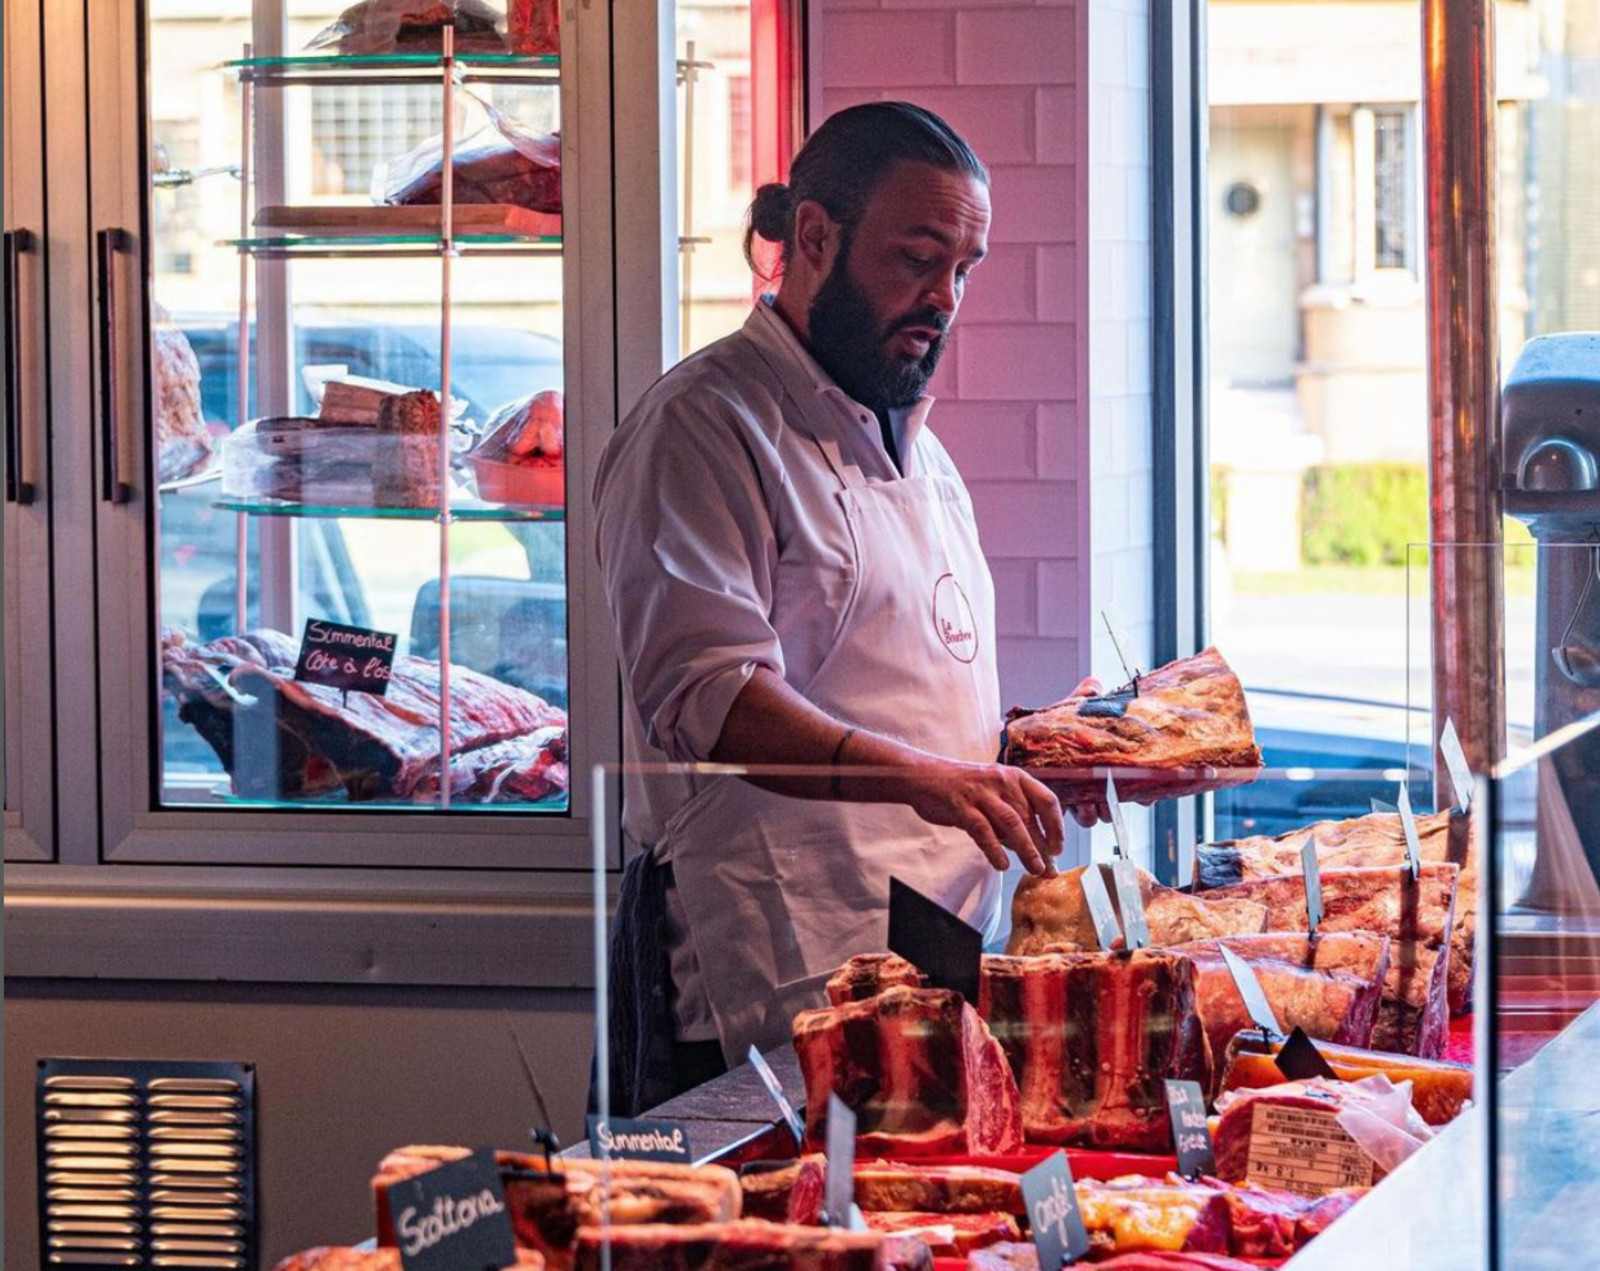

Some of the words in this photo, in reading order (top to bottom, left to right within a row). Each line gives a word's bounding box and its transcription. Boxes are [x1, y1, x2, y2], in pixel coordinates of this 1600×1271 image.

[308, 621, 392, 652] Simmental
[343, 657, 358, 674] à
[596, 1121, 685, 1154] Simmental
[400, 1189, 504, 1256] Scottona
